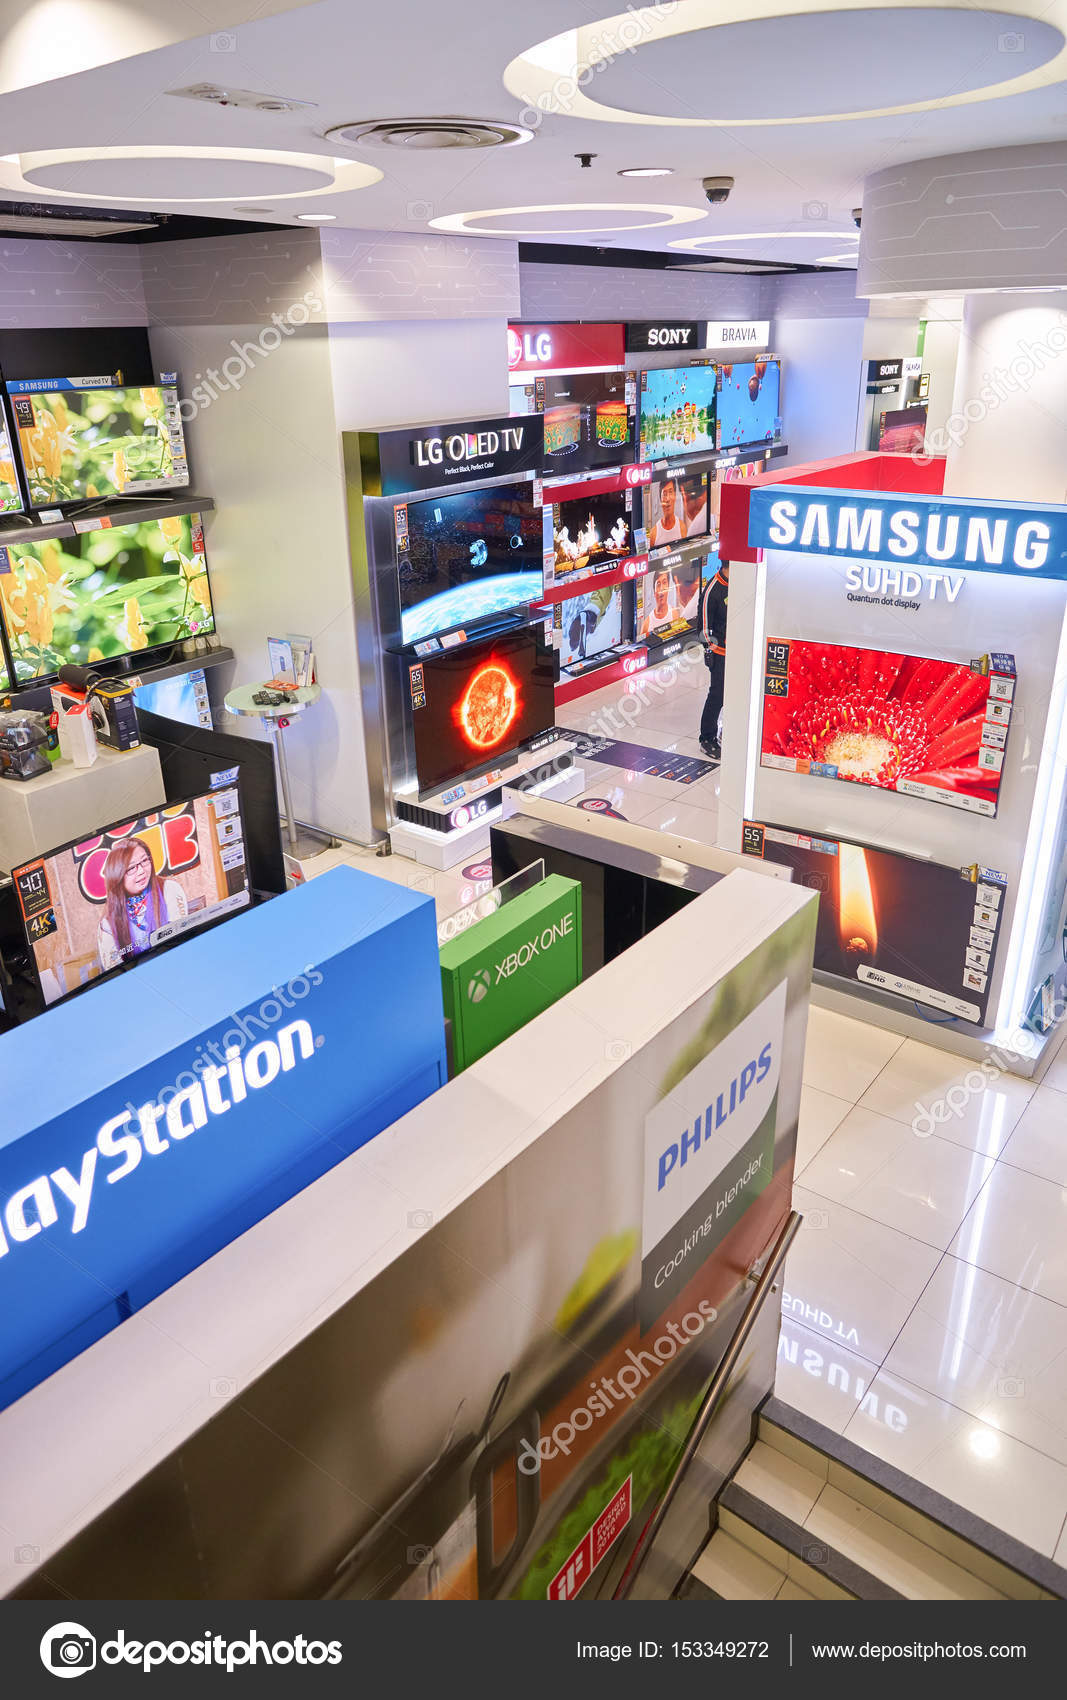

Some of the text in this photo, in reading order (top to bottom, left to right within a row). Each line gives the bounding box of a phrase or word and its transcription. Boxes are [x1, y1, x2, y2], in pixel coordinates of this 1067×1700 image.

[647, 328, 691, 346] SONY
[721, 327, 757, 342] BRAVIA
[524, 332, 552, 362] LG
[880, 364, 900, 376] SONY
[18, 380, 59, 391] SAMSUNG
[81, 376, 109, 386] Curved TV
[417, 427, 524, 467] LG OLED TV
[639, 468, 650, 480] LG
[666, 467, 686, 478] BRAVIA
[768, 499, 1051, 570] SAMSUNG
[635, 562, 647, 574] LG
[845, 565, 966, 603] SUHD TV
[846, 593, 921, 611] Quantum dot display
[635, 658, 646, 669] LG
[767, 679, 784, 691] 4K
[215, 771, 234, 783] NEW
[470, 800, 487, 819] LG
[984, 870, 1003, 880] NEW
[30, 912, 52, 934] 4K
[495, 912, 574, 985] XBOX ONE
[657, 1041, 772, 1193] PHILIPS
[0, 1018, 315, 1258] ayStation
[653, 1152, 764, 1289] Cooking blender
[597, 1493, 625, 1537] DESIGN
[597, 1501, 627, 1547] AWARD
[597, 1526, 616, 1555] 2016
